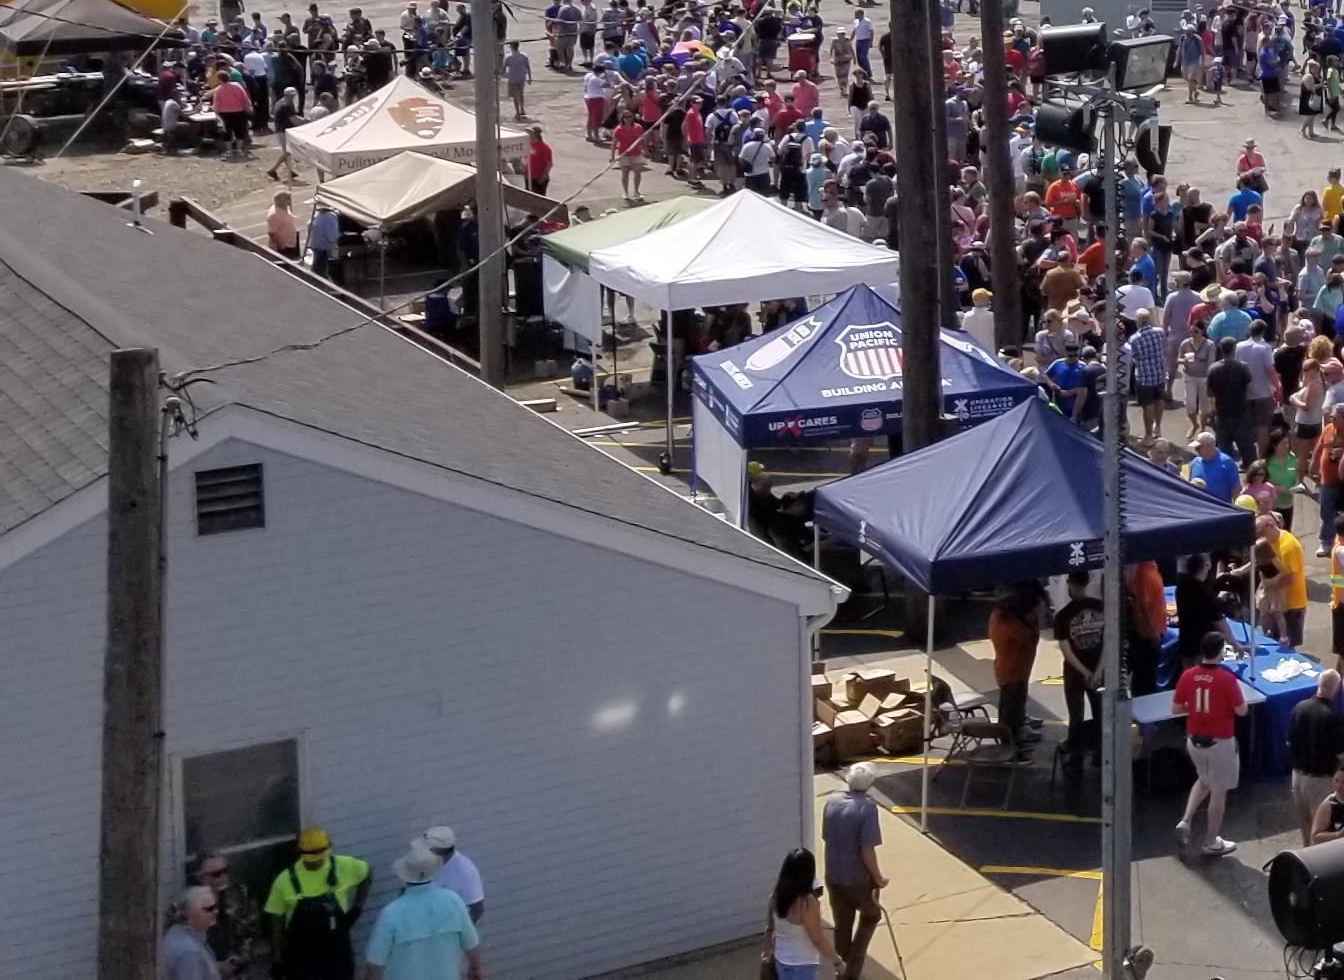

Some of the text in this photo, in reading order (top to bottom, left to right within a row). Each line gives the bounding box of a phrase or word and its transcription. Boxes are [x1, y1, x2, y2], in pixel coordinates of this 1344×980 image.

[849, 330, 893, 341] UNION
[849, 338, 898, 350] PACIFIC
[821, 382, 887, 398] BUILDING
[768, 415, 838, 432] UP CARES
[1195, 687, 1210, 714] 11
